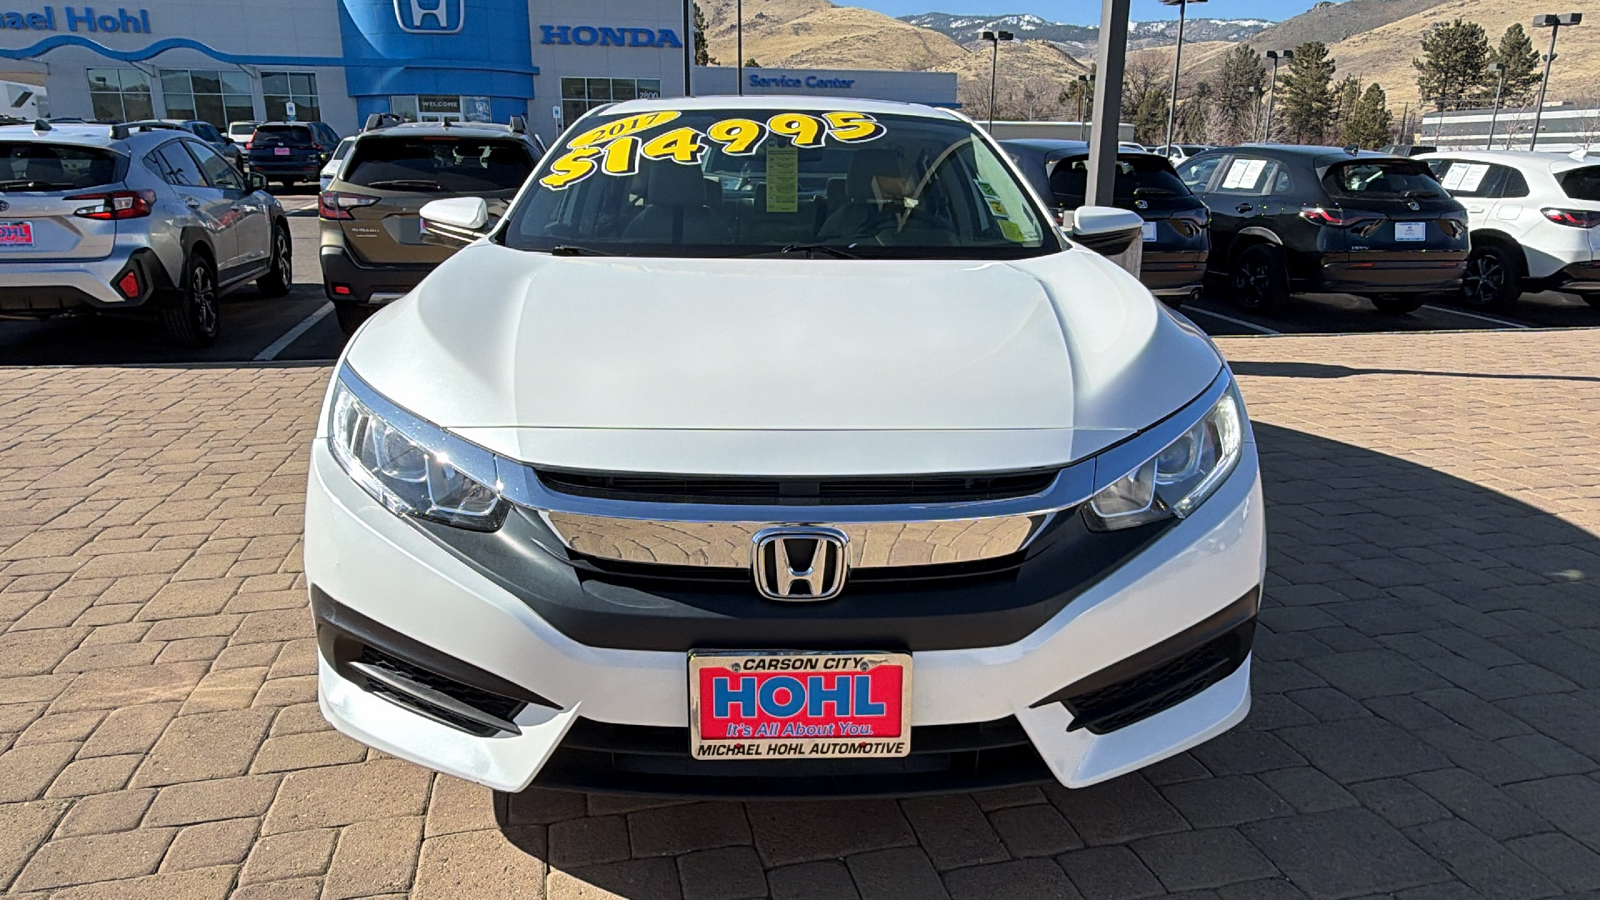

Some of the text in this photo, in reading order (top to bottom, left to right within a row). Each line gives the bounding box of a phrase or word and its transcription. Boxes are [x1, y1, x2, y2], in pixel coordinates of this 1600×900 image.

[65, 6, 151, 34] Hohl
[540, 25, 683, 48] HONDA
[749, 74, 855, 89] Service Center
[639, 91, 659, 99] 2800
[591, 112, 661, 143] 2017
[539, 111, 887, 191] $14995
[742, 657, 864, 671] CARSON CITY
[713, 675, 885, 718] HOHL
[726, 721, 874, 736] It's All About You.
[697, 742, 905, 756] MICHAEL HOHL AUTOMOTIVE
